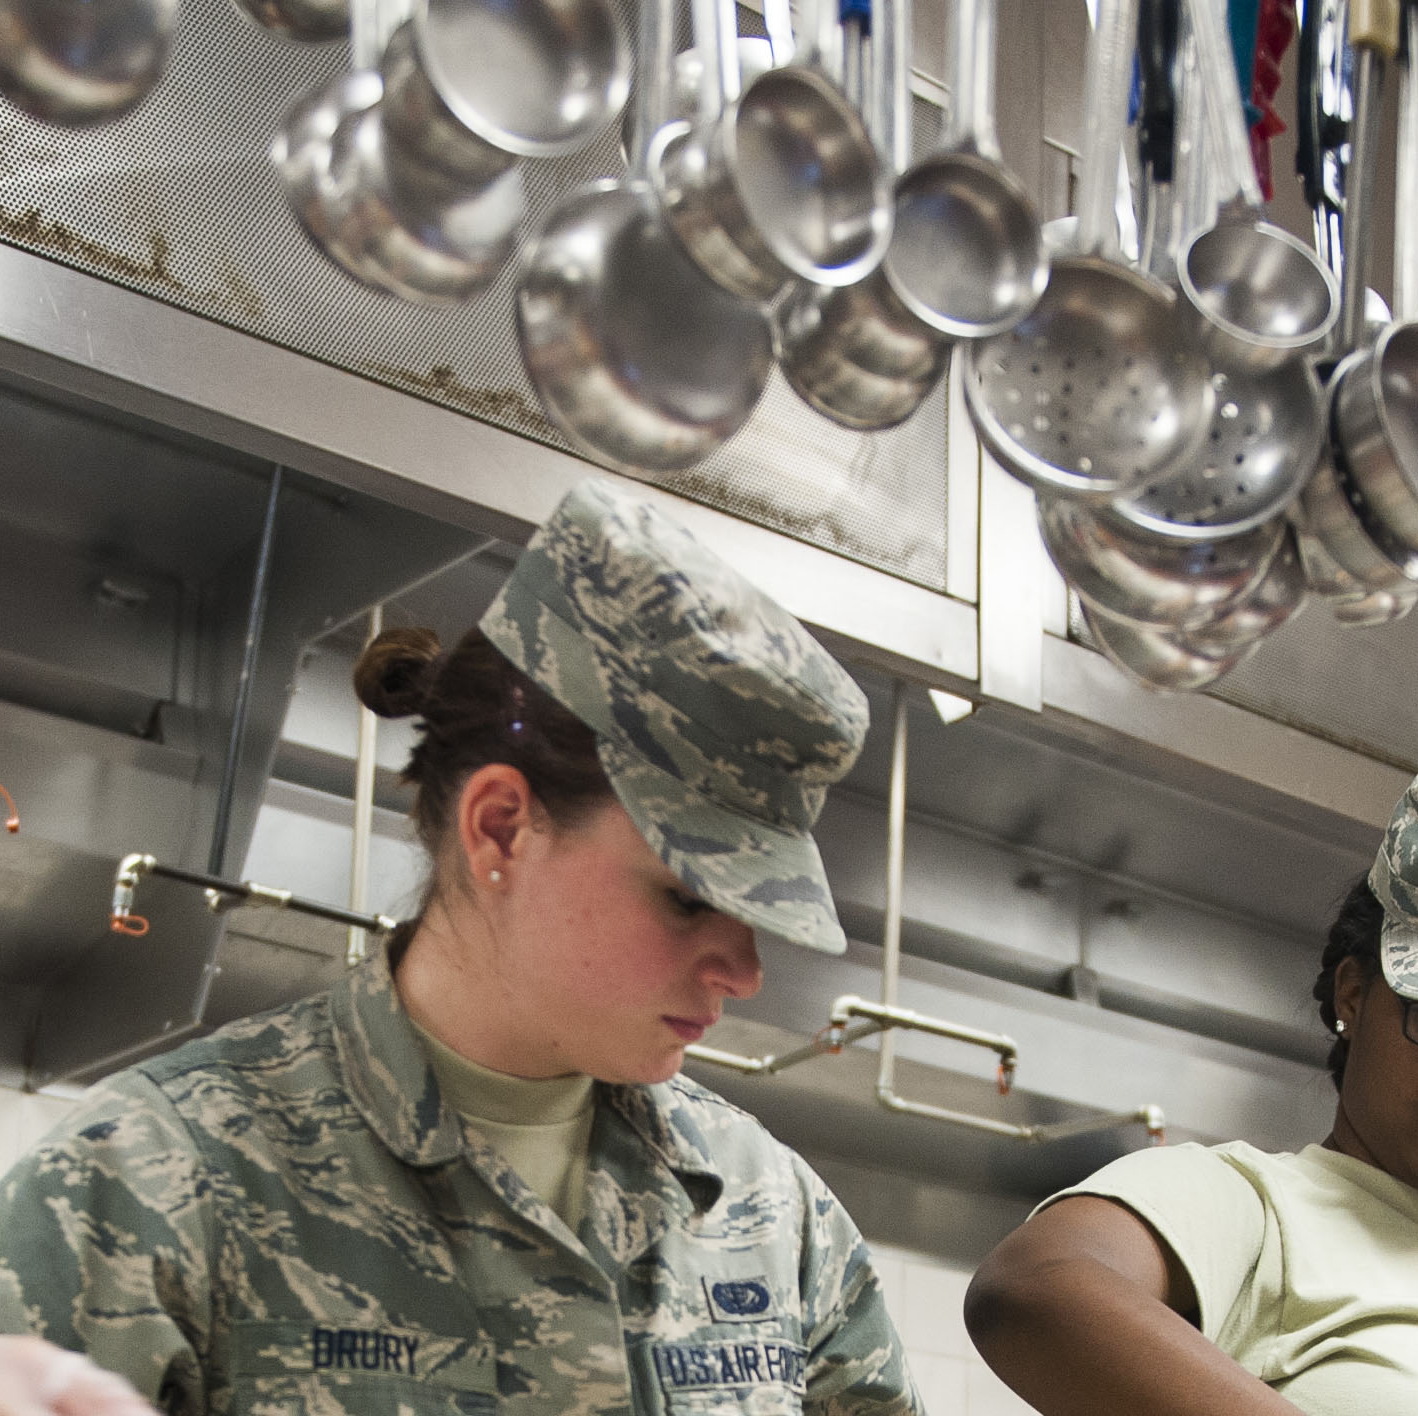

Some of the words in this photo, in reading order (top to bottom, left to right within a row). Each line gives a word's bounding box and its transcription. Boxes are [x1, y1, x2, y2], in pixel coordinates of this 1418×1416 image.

[314, 1328, 419, 1375] DRURY
[720, 1345, 763, 1383] AIR
[764, 1344, 806, 1387] FOCE
